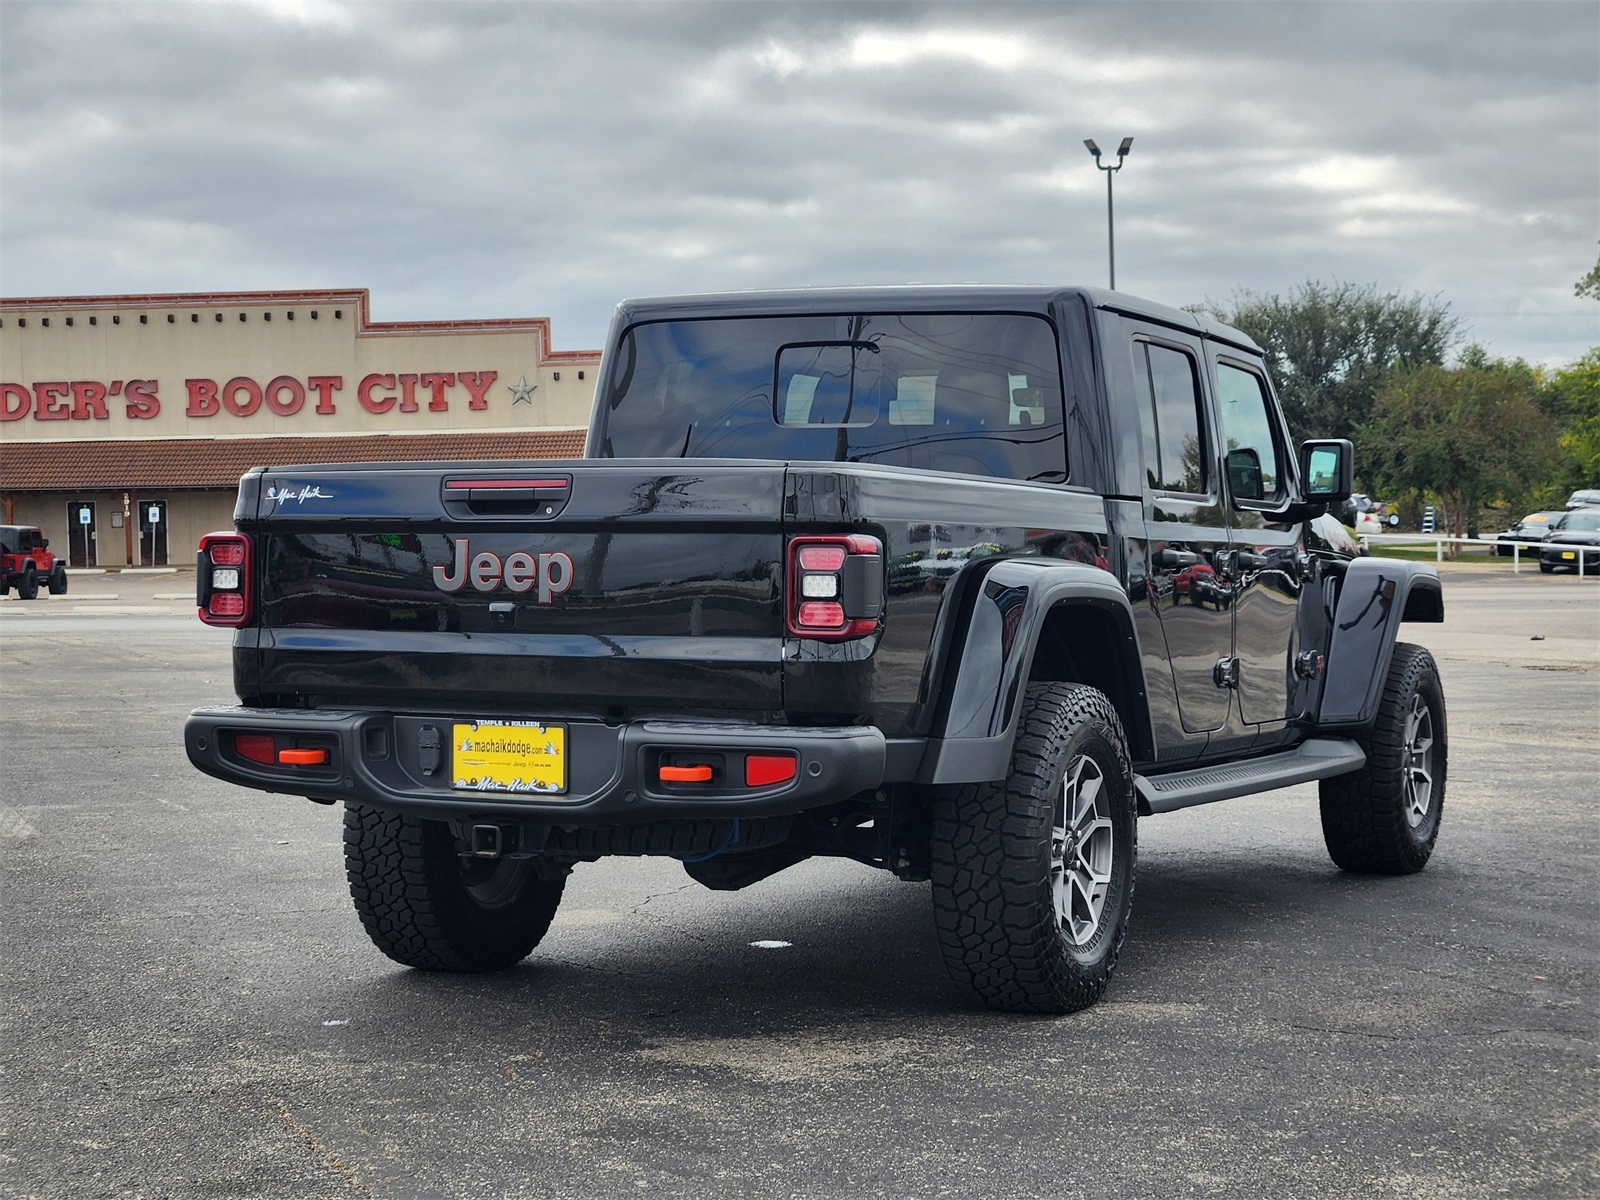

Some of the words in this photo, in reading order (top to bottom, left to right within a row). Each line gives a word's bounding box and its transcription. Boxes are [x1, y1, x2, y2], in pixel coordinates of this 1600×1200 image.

[0, 379, 161, 421] DER'S
[185, 376, 343, 417] BOOT
[357, 371, 498, 415] CITY
[432, 539, 574, 604] Jeep
[476, 719, 503, 727] TEMPLE
[511, 720, 540, 728] KILLEEN
[474, 739, 543, 757] machaikdodge.com
[475, 776, 505, 791] Mac
[506, 777, 542, 792] Haik
